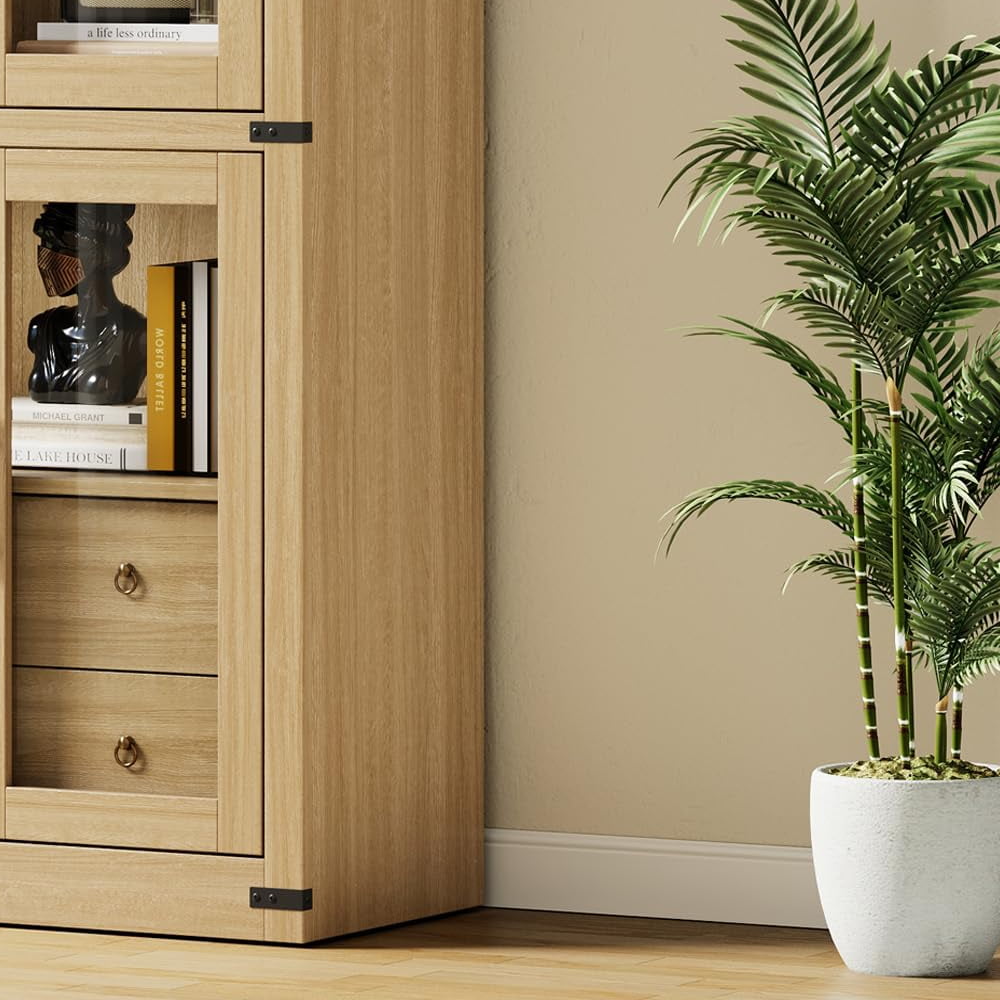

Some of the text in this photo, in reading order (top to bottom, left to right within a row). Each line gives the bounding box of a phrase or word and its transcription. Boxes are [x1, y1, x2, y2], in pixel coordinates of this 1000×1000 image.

[87, 27, 182, 41] a life less ordinary
[32, 412, 105, 422] MICHAEL GRANT
[27, 450, 62, 462] LAKE
[66, 451, 113, 465] HOUSE
